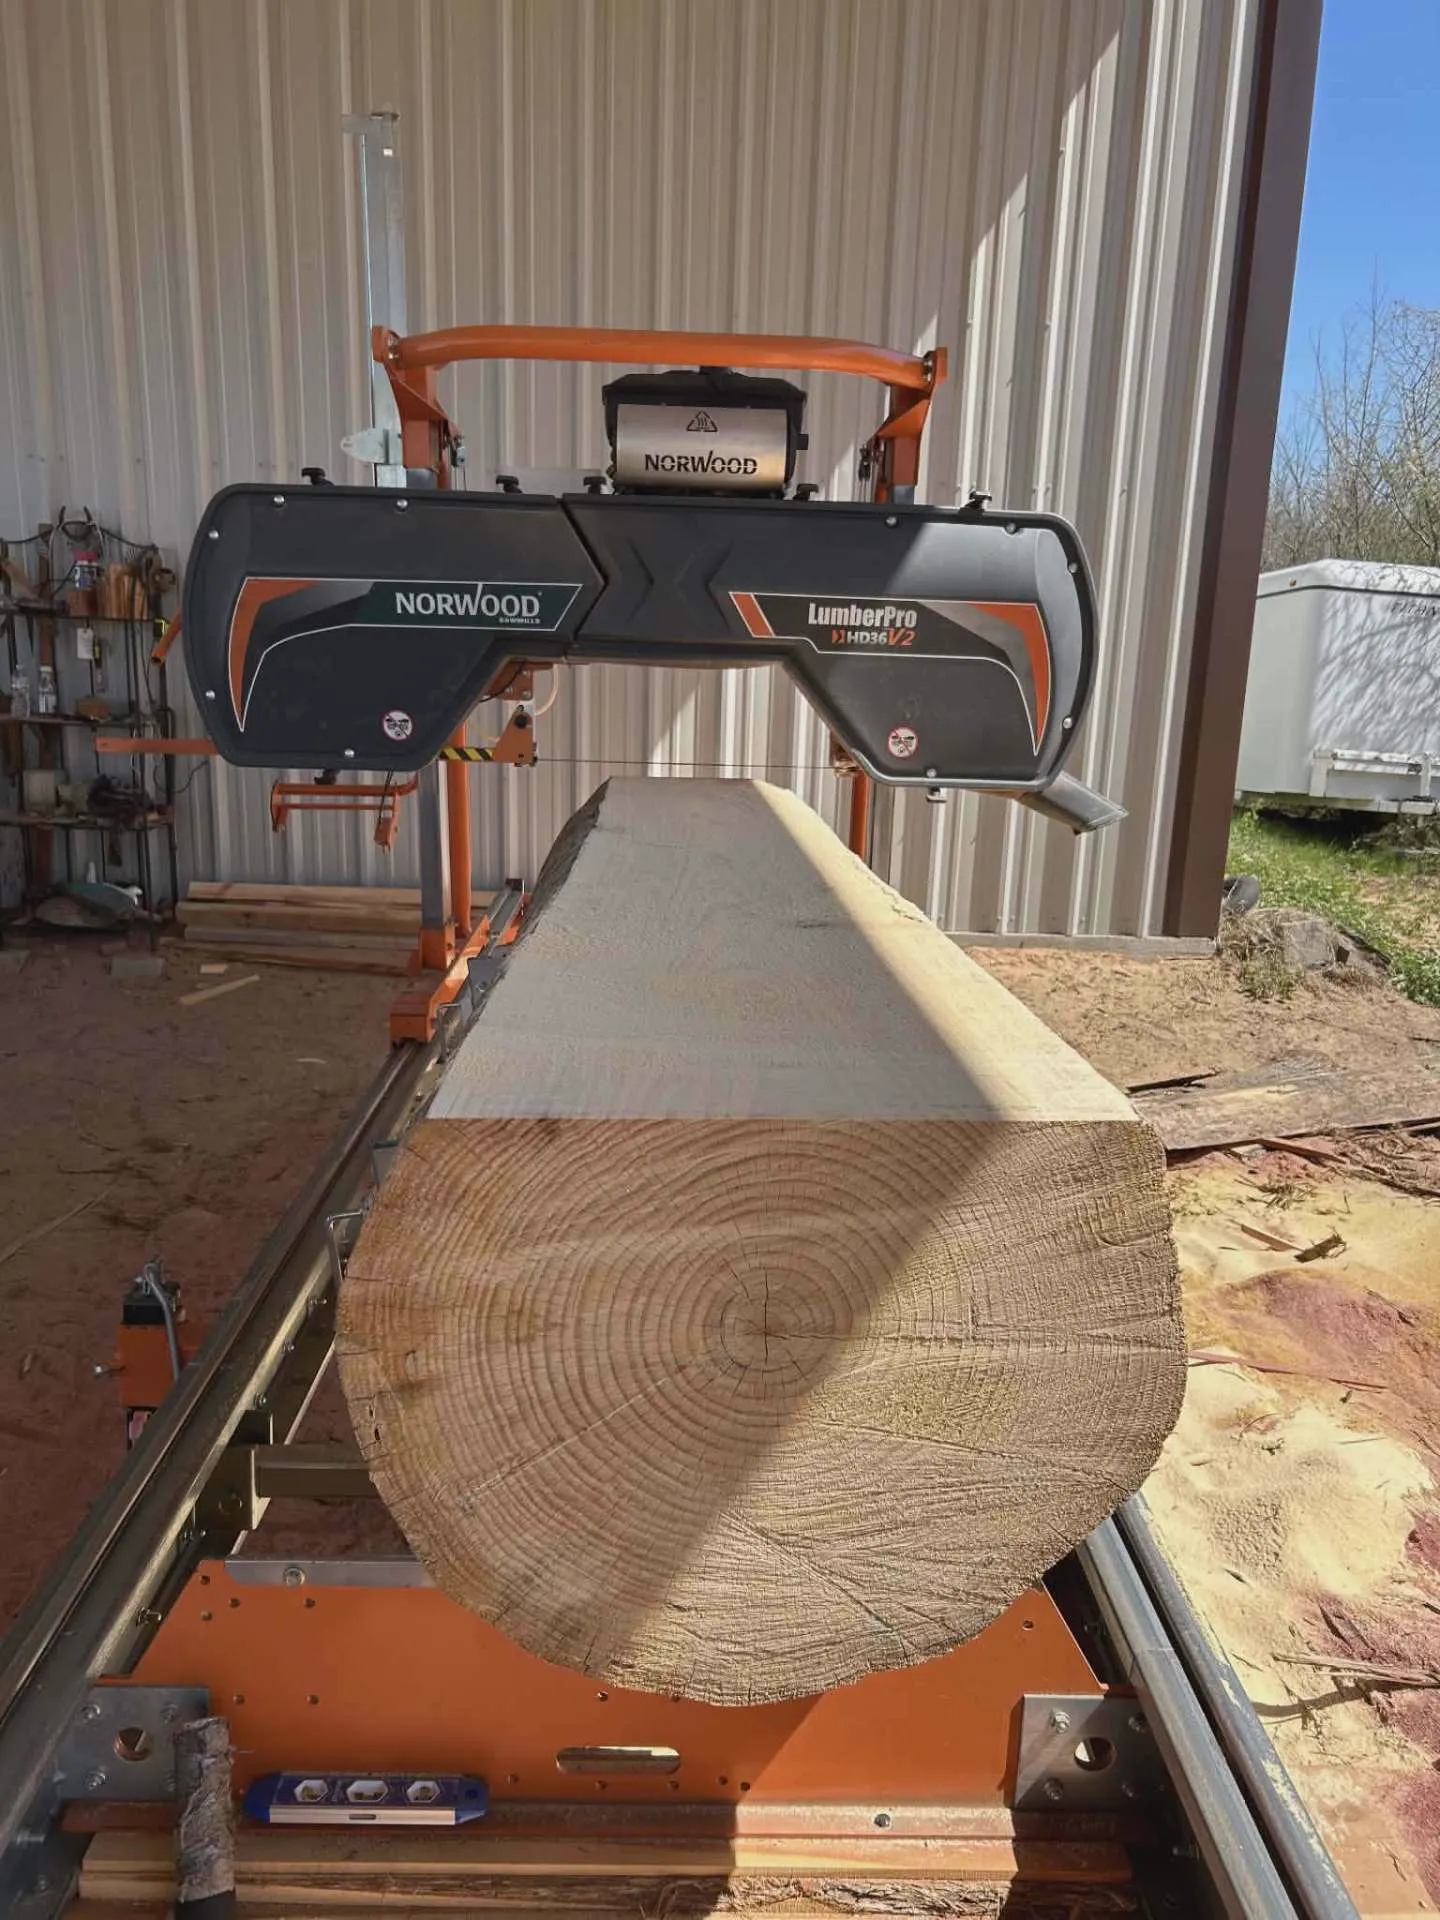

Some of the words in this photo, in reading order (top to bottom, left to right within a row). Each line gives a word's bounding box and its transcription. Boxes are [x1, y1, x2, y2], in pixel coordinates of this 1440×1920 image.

[644, 450, 757, 475] NORWOOD
[395, 583, 540, 617] NORWOOD
[808, 602, 917, 628] LumberPro
